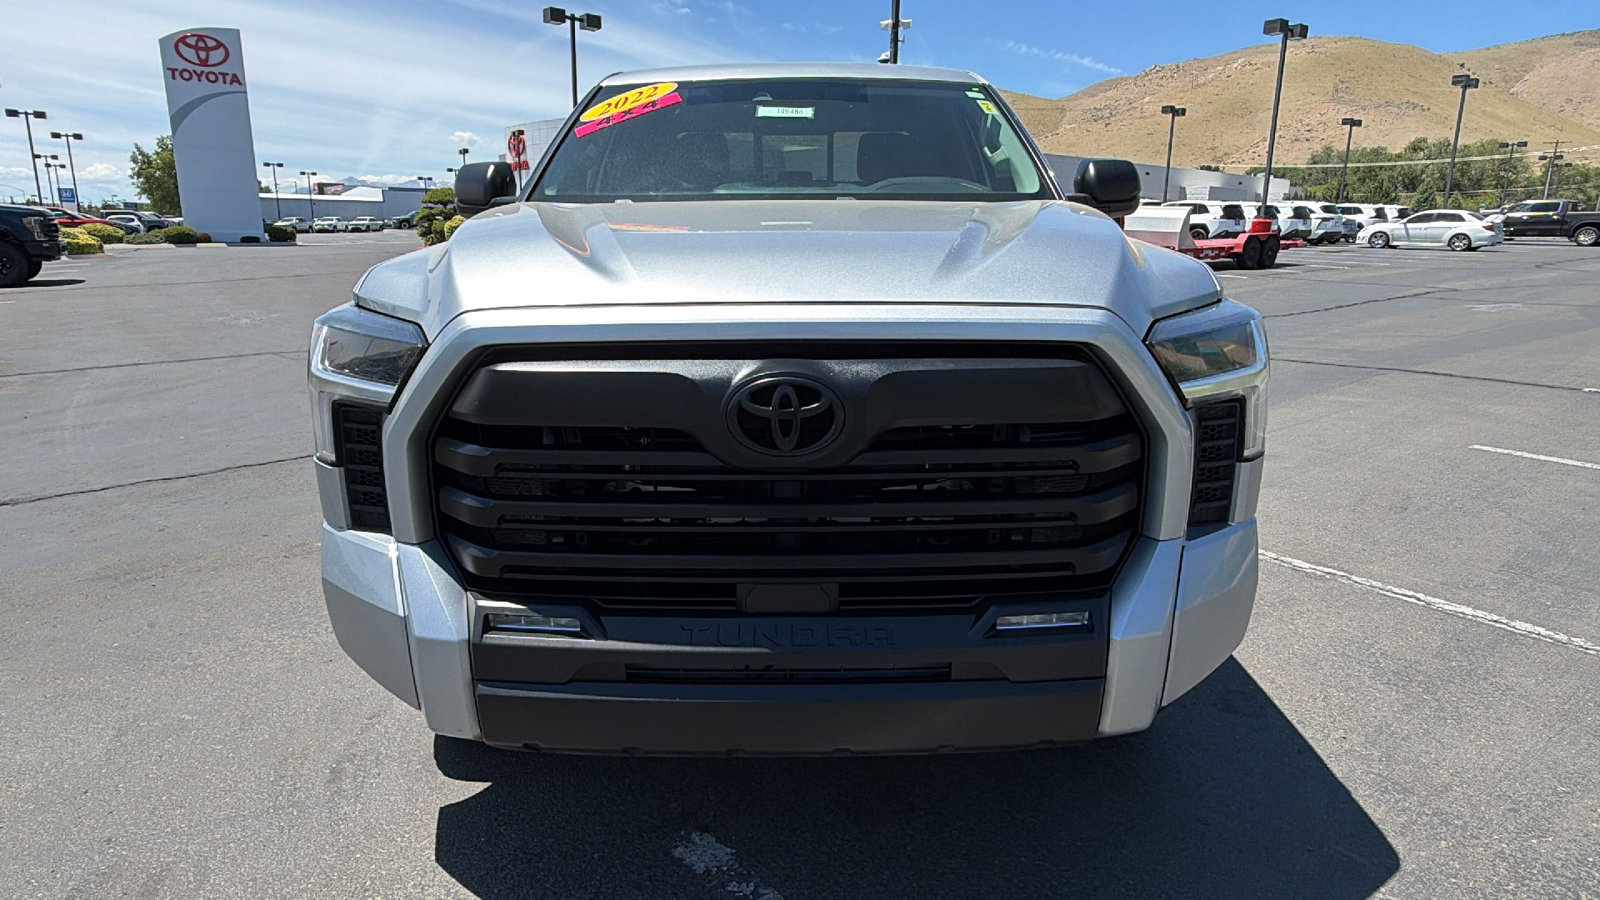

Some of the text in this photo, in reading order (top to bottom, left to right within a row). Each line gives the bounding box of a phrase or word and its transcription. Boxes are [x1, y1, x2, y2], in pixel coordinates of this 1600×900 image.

[167, 67, 242, 85] TOYOTA
[600, 86, 659, 116] 2022
[679, 624, 897, 646] TUNDRA
